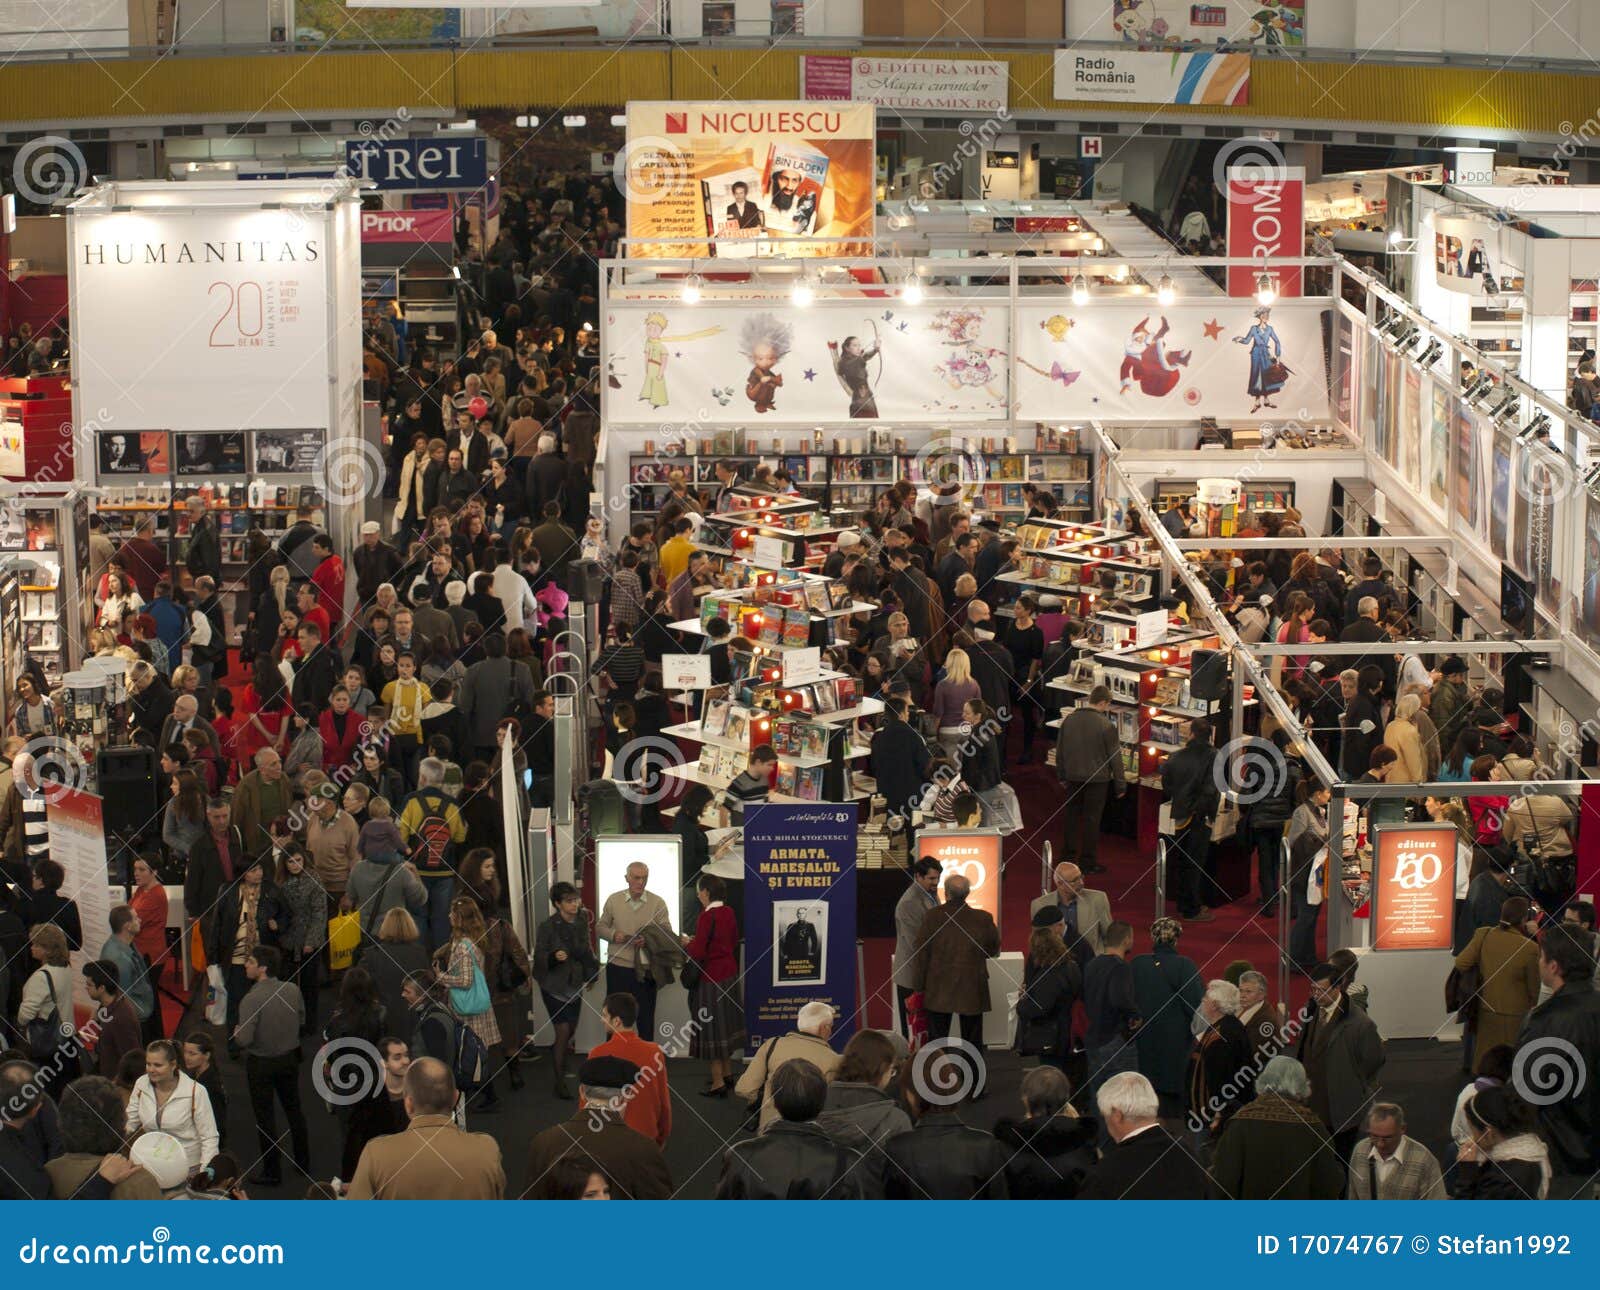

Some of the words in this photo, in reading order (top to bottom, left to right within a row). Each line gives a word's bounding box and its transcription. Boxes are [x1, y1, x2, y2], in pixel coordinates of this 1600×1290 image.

[877, 62, 958, 76] EDITURA
[966, 64, 1000, 76] MIX
[1075, 57, 1115, 70] Radio
[1075, 71, 1136, 84] România
[701, 112, 841, 134] NICULESCU
[1085, 141, 1099, 155] H
[775, 156, 792, 168] BIN
[793, 160, 825, 175] LADEN
[1467, 171, 1492, 182] DDC
[363, 213, 415, 233] Prior
[83, 240, 319, 265] HUMANITAS
[208, 281, 263, 347] 20
[938, 845, 980, 856] editura
[1397, 839, 1437, 849] editura
[769, 848, 830, 860] ARMATA,
[759, 862, 841, 876] MAREȘALUL
[1390, 851, 1443, 890] rao
[768, 877, 782, 891] ȘI
[786, 876, 832, 888] EVREII
